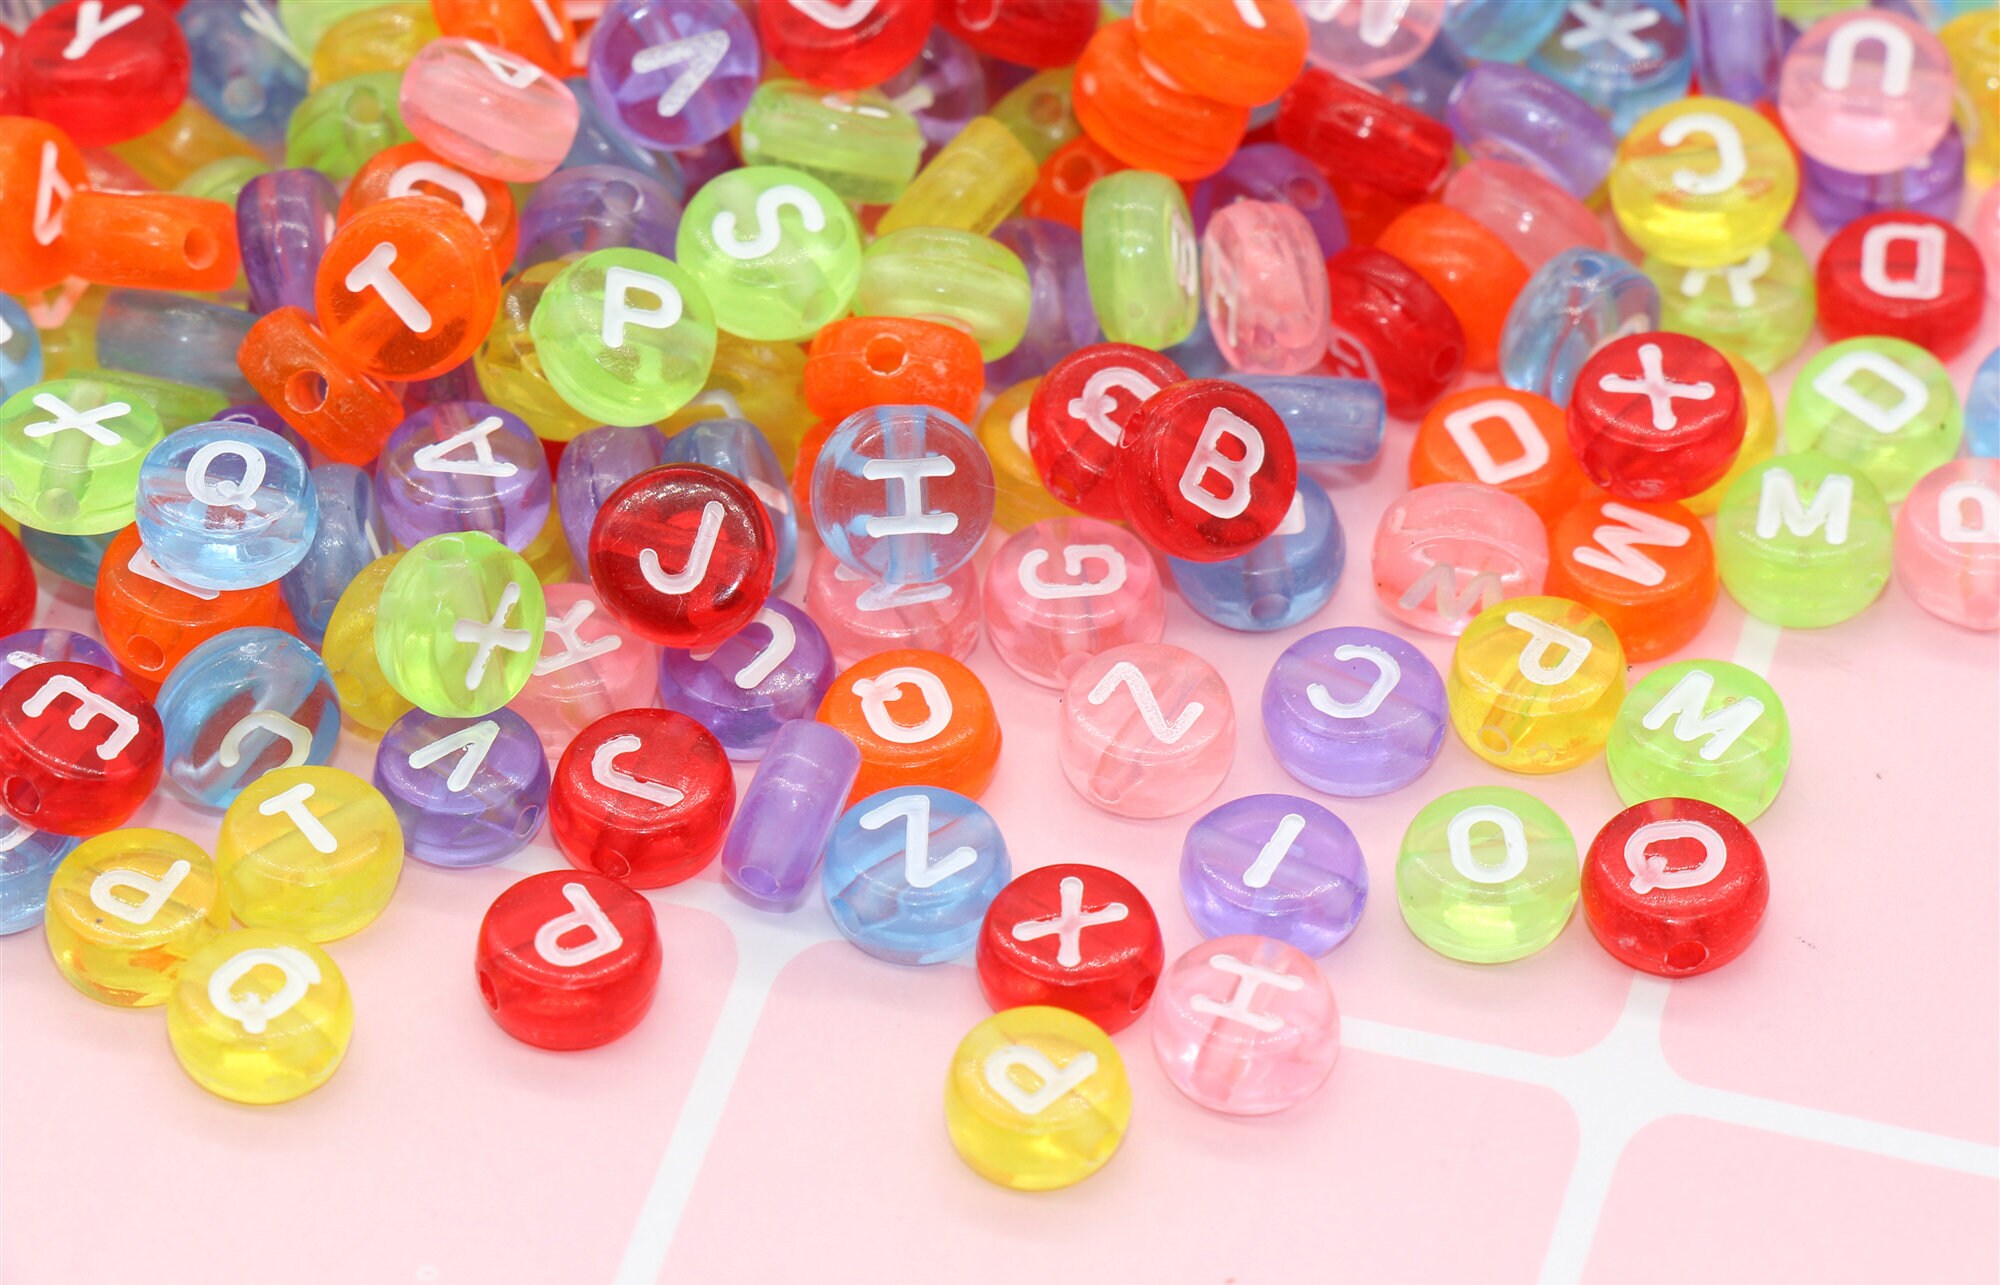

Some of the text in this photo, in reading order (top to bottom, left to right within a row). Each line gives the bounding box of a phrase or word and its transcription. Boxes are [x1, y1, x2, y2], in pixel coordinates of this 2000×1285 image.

[62, 0, 144, 59] Y
[1561, 1, 1660, 59] X
[1659, 112, 1747, 195] C
[711, 184, 826, 260] S
[1860, 222, 1946, 300] D
[345, 241, 432, 333] T
[602, 266, 683, 348] P
[23, 393, 132, 447] X
[1599, 344, 1715, 430] X
[1813, 350, 1929, 434] D
[185, 439, 267, 510] Q
[413, 416, 519, 478] A
[1178, 406, 1265, 519] B
[1444, 399, 1550, 485] D
[863, 455, 959, 538] H
[1756, 467, 1853, 545] M
[639, 500, 725, 595] J
[1018, 543, 1127, 599] G
[453, 581, 531, 691] X
[1505, 611, 1592, 686] P
[22, 674, 139, 761] E
[852, 666, 953, 744] Q
[1306, 644, 1401, 719] C
[1642, 670, 1765, 761] M
[592, 734, 684, 807] J
[259, 783, 338, 854] T
[1447, 805, 1528, 883] O
[1624, 820, 1727, 894] Q
[90, 859, 192, 925] P
[534, 883, 623, 967] P
[1012, 876, 1128, 966] X
[208, 947, 322, 1034] Q
[1190, 953, 1304, 1033] H
[986, 1045, 1098, 1115] P
